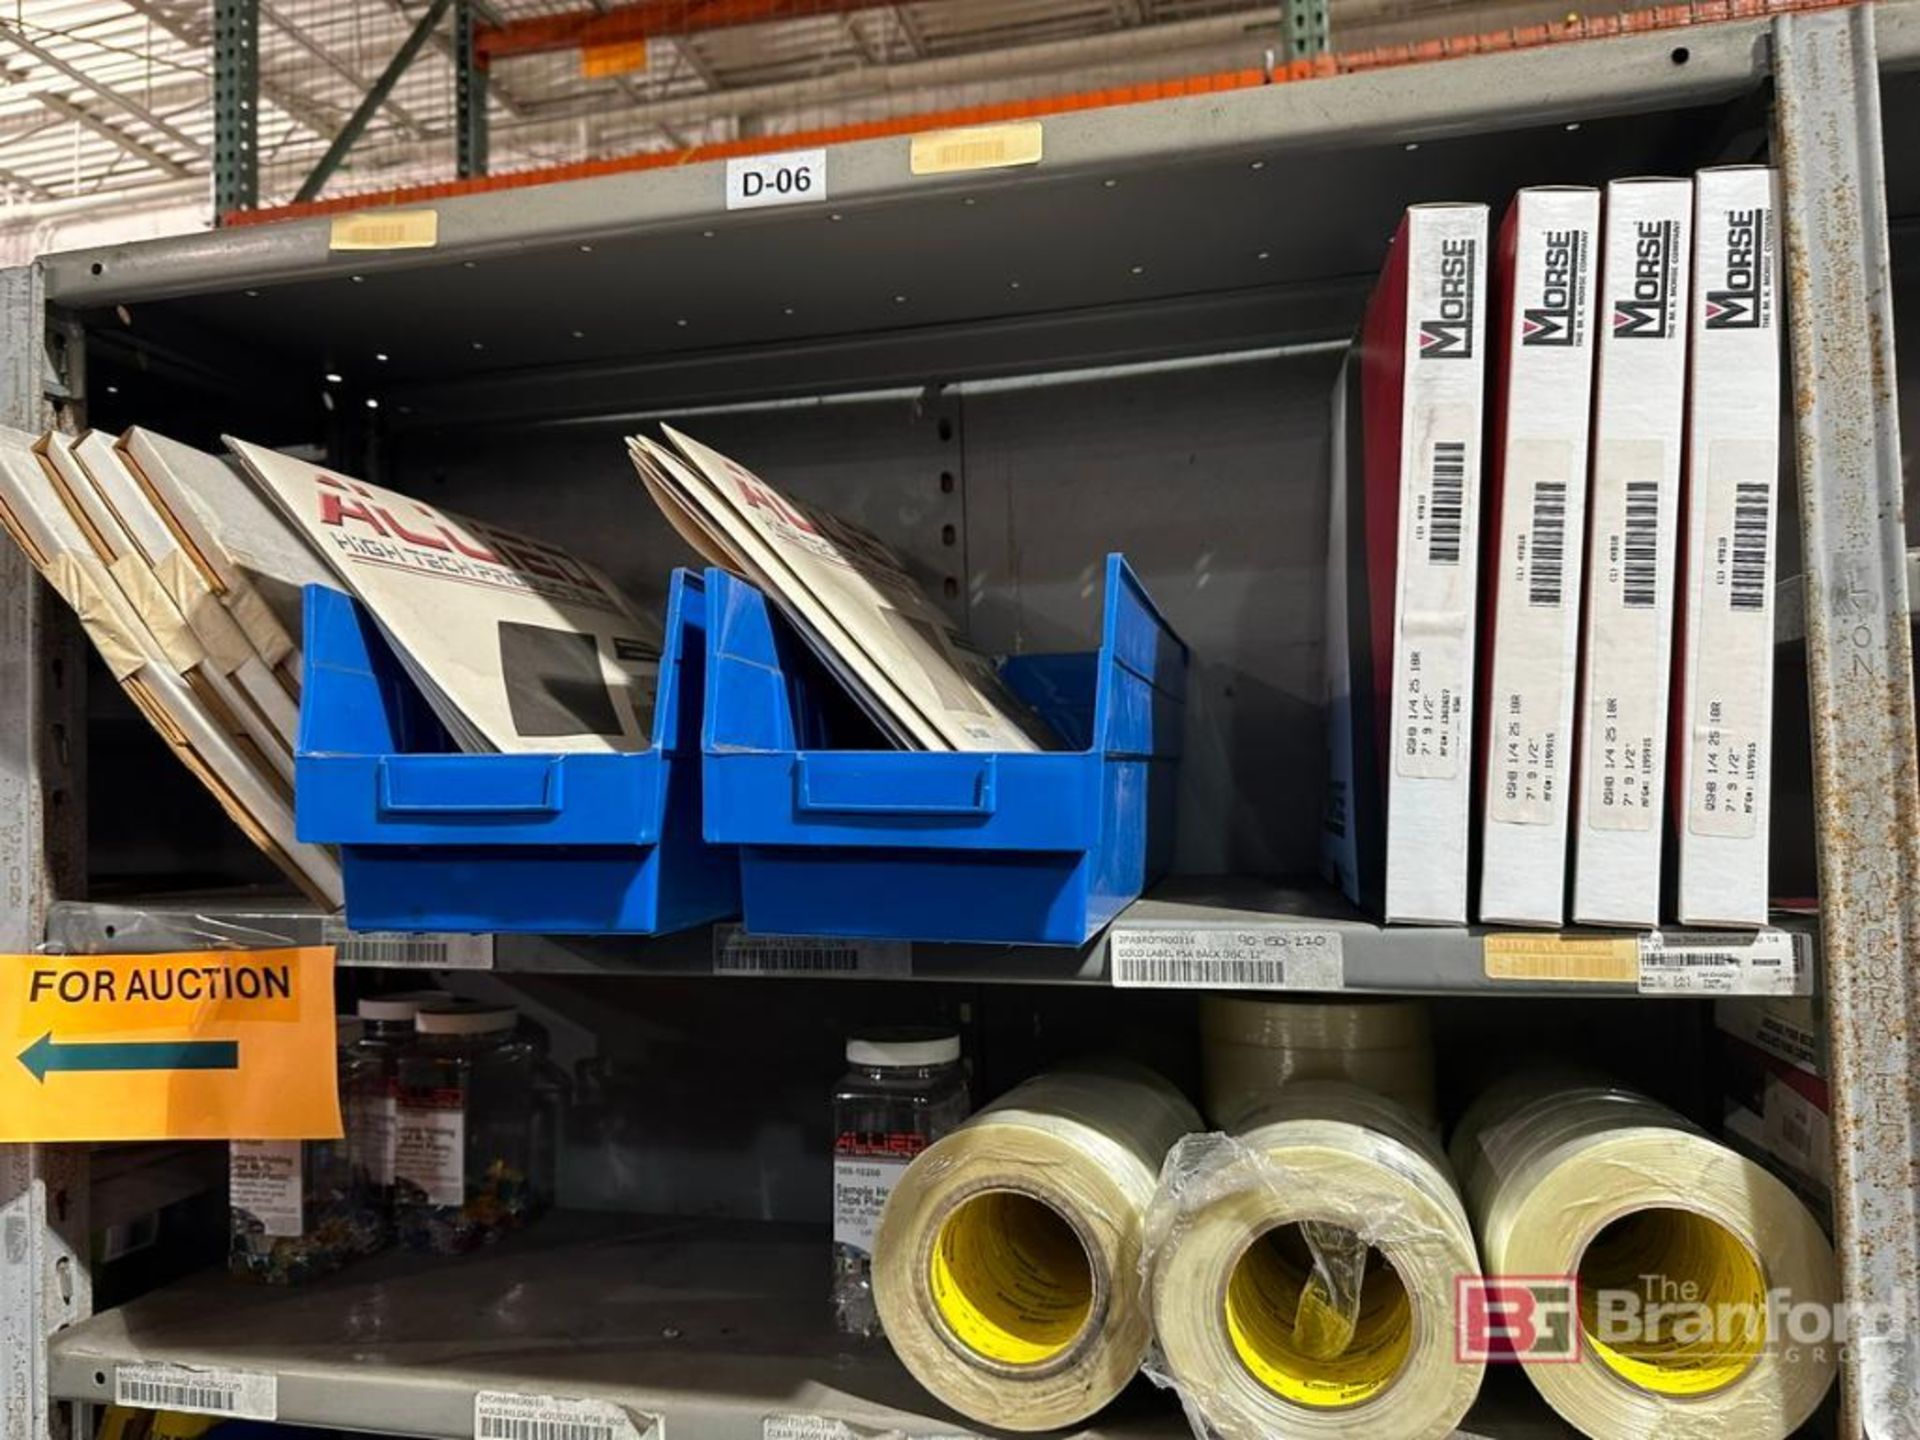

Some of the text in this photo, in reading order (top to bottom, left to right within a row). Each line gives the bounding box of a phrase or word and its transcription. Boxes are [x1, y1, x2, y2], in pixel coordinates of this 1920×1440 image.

[742, 166, 811, 197] D-06
[1613, 219, 1672, 338] MORSE
[1704, 208, 1762, 330] MORSE
[1522, 229, 1580, 346] MORSE
[1419, 239, 1476, 359] MORSE
[1408, 678, 1420, 694] 25
[1408, 699, 1418, 720] 1/4
[1508, 721, 1520, 737] 25
[1604, 726, 1617, 743] 25
[1707, 730, 1720, 746] 25
[1508, 742, 1519, 763] 1/4
[1604, 748, 1615, 769] 1/4
[1707, 752, 1718, 774] 1/4
[29, 965, 292, 1003] FOR AUCTION
